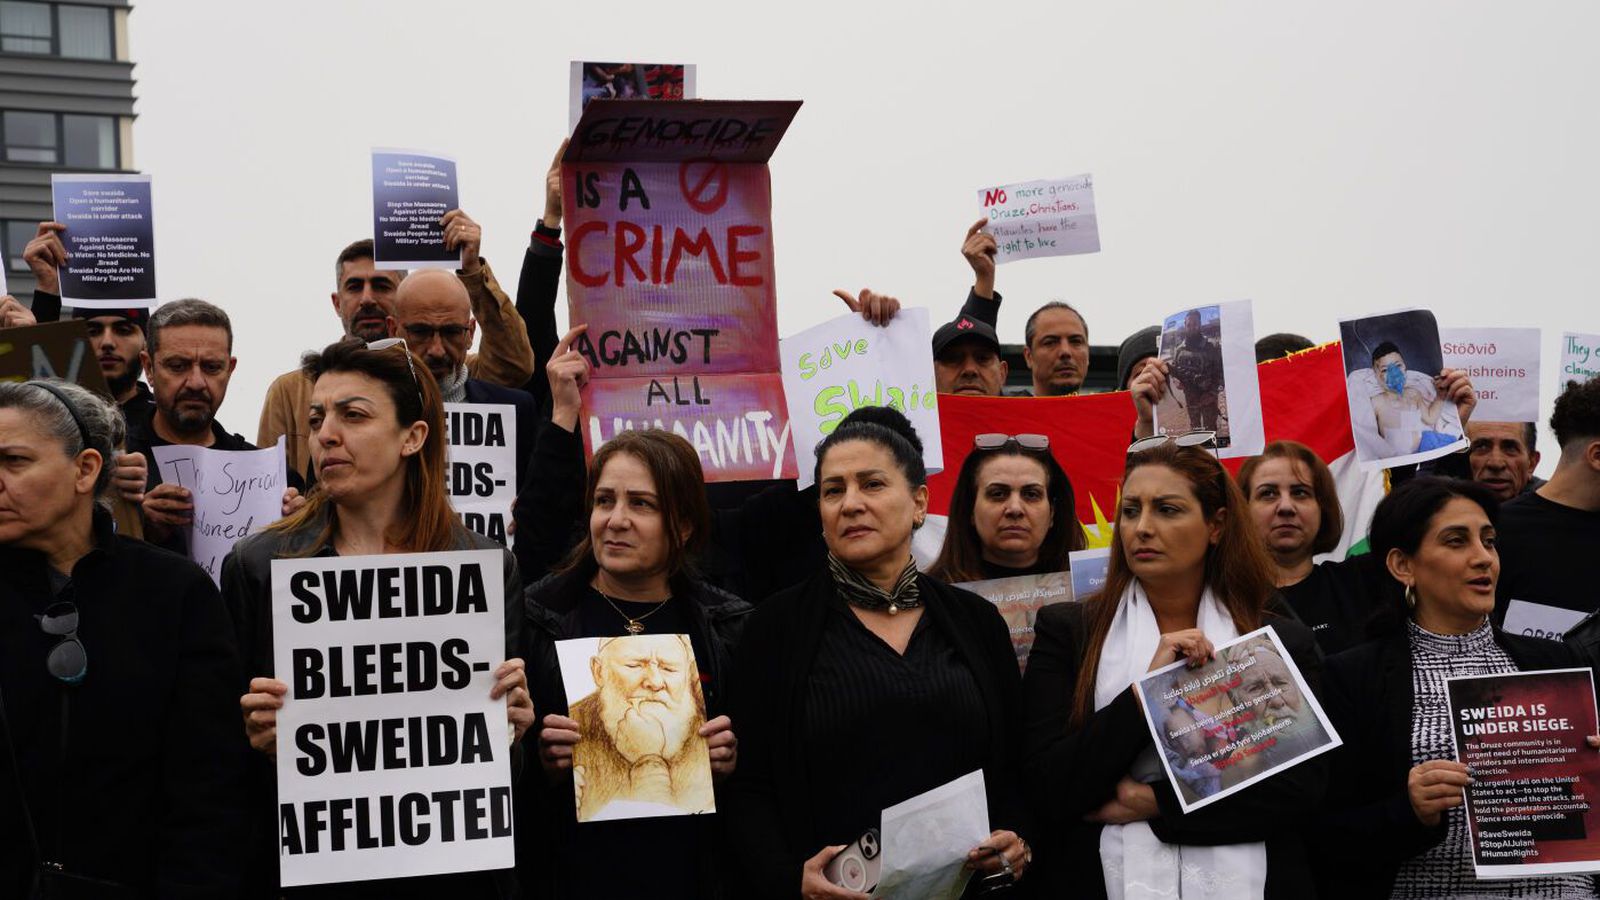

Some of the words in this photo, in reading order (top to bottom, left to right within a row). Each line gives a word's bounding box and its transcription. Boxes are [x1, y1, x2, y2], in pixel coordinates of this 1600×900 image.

[580, 116, 780, 145] GENOCIDE
[576, 171, 600, 208] IS
[619, 168, 650, 211] A
[984, 188, 1007, 207] NO
[1015, 187, 1043, 199] more
[1038, 223, 1057, 233] have
[1060, 218, 1078, 230] the
[79, 244, 105, 252] Against
[1024, 238, 1034, 249] to
[1038, 238, 1056, 248] live
[569, 220, 764, 288] CRIME
[81, 275, 107, 283] Military
[108, 275, 134, 283] Targets
[94, 268, 117, 276] People
[570, 327, 720, 368] AGAINST
[1443, 342, 1497, 355] Stöðvið
[1564, 336, 1590, 364] They
[647, 376, 711, 406] ALL
[290, 563, 488, 624] SWEIDA
[293, 638, 490, 700] BLEEDS-
[1214, 704, 1245, 720] subjected
[1253, 688, 1282, 705] genocide
[1460, 705, 1526, 721] SWEIDA
[1530, 704, 1547, 716] IS
[1462, 720, 1521, 736] UNDER
[1522, 718, 1574, 733] SIEGE.
[295, 712, 494, 777] SWEIDA
[1503, 740, 1545, 748] community
[1466, 752, 1492, 760] urgent
[1468, 759, 1501, 767] corridors
[1517, 756, 1566, 765] international
[1484, 779, 1515, 788] urgently
[1471, 789, 1495, 797] States
[1533, 786, 1550, 794] stop
[1473, 797, 1513, 805] massacres,
[1542, 794, 1570, 802] attacks,
[1505, 804, 1552, 814] perpetrators
[281, 786, 512, 856] AFFLICTED
[1475, 815, 1502, 823] Silence
[1532, 813, 1567, 821] genocide.
[1478, 829, 1532, 839] #SaveSweida
[1481, 849, 1539, 858] #HumanRights
